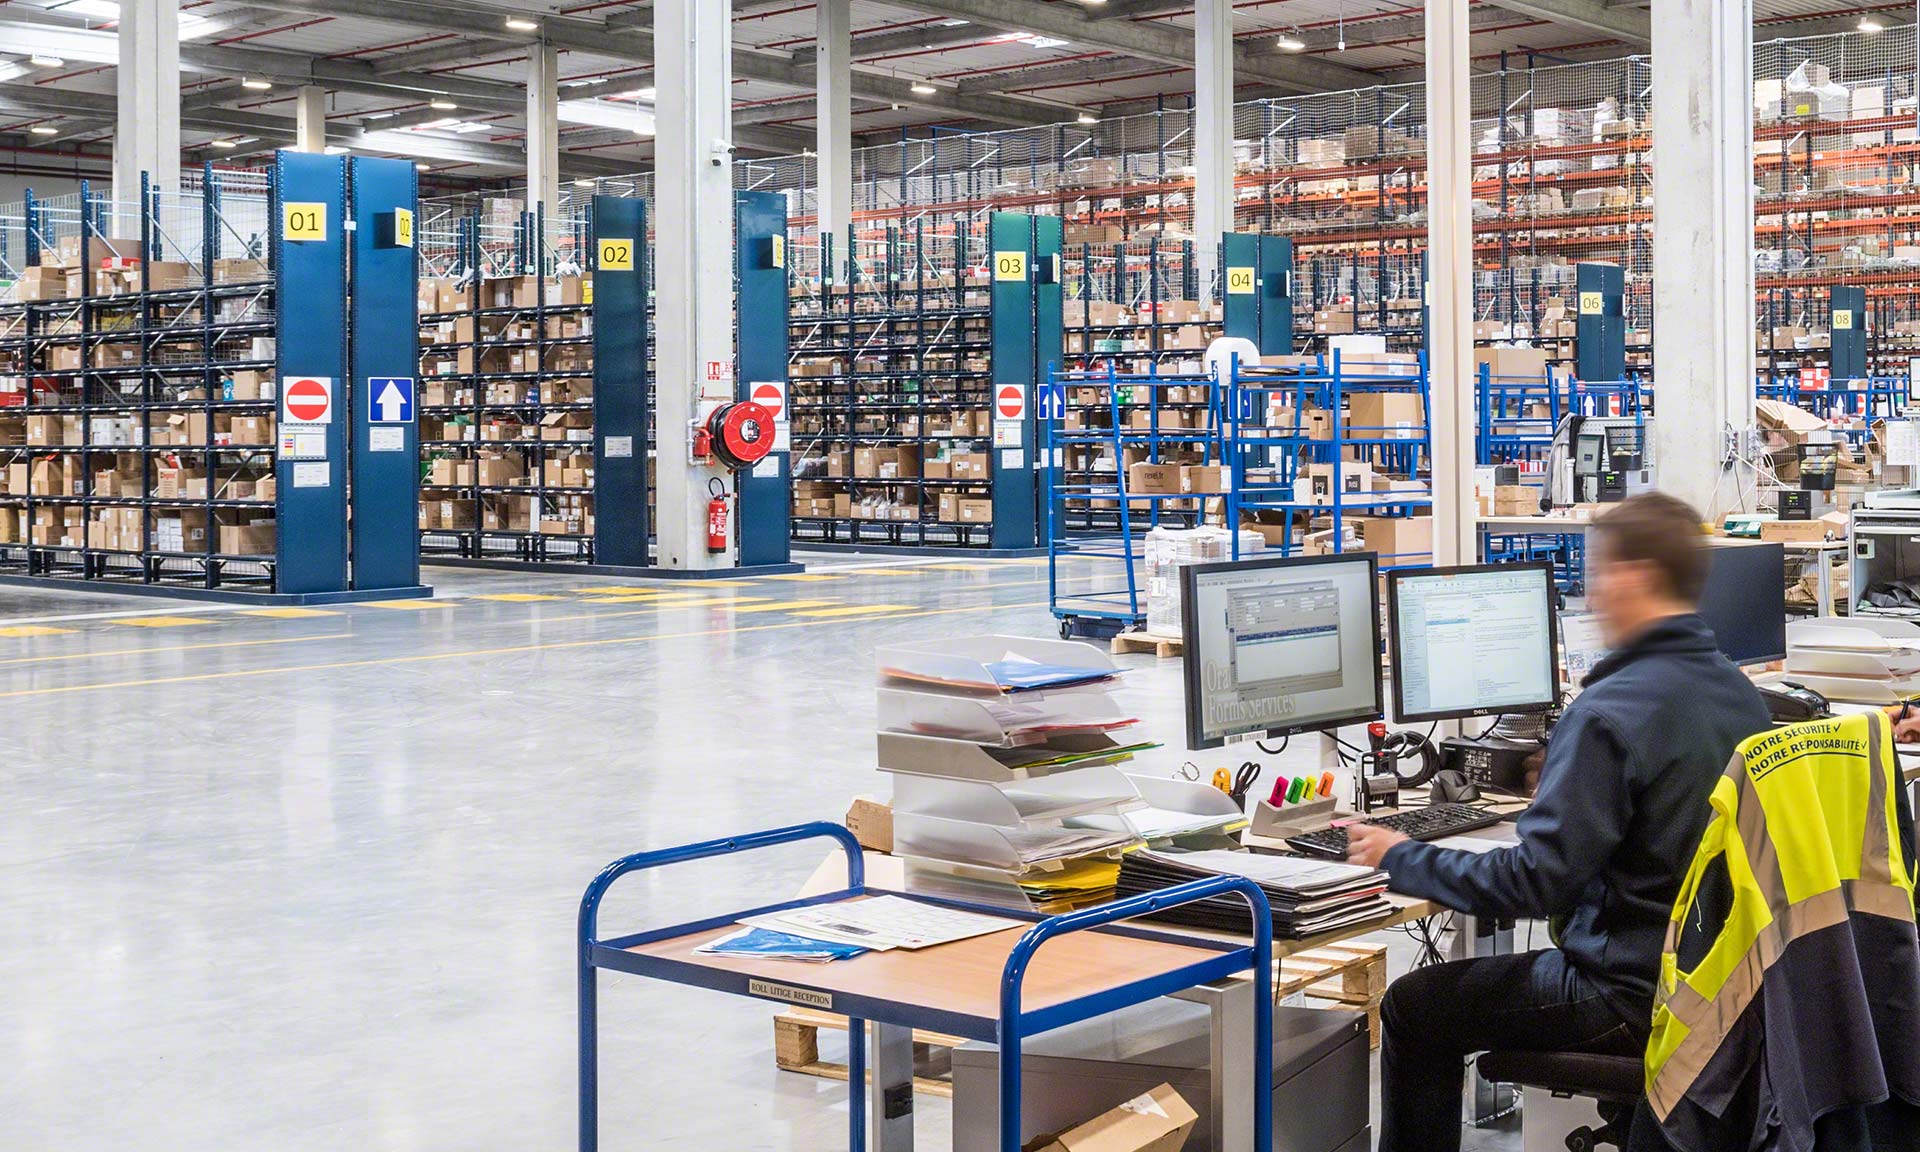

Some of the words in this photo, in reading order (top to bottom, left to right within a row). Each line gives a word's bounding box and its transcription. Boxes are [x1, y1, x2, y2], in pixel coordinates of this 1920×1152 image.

[290, 211, 319, 232] 01
[400, 217, 410, 238] 02
[603, 246, 628, 263] 02
[999, 258, 1021, 274] 03
[1231, 273, 1251, 287] 04
[1583, 297, 1600, 309] 06
[1835, 314, 1850, 325] 08
[1206, 661, 1231, 691] Ora
[1208, 694, 1245, 724] Forms
[1745, 733, 1783, 762] NOTRE
[1750, 747, 1789, 776] NOTRE
[751, 982, 769, 994] ROLL
